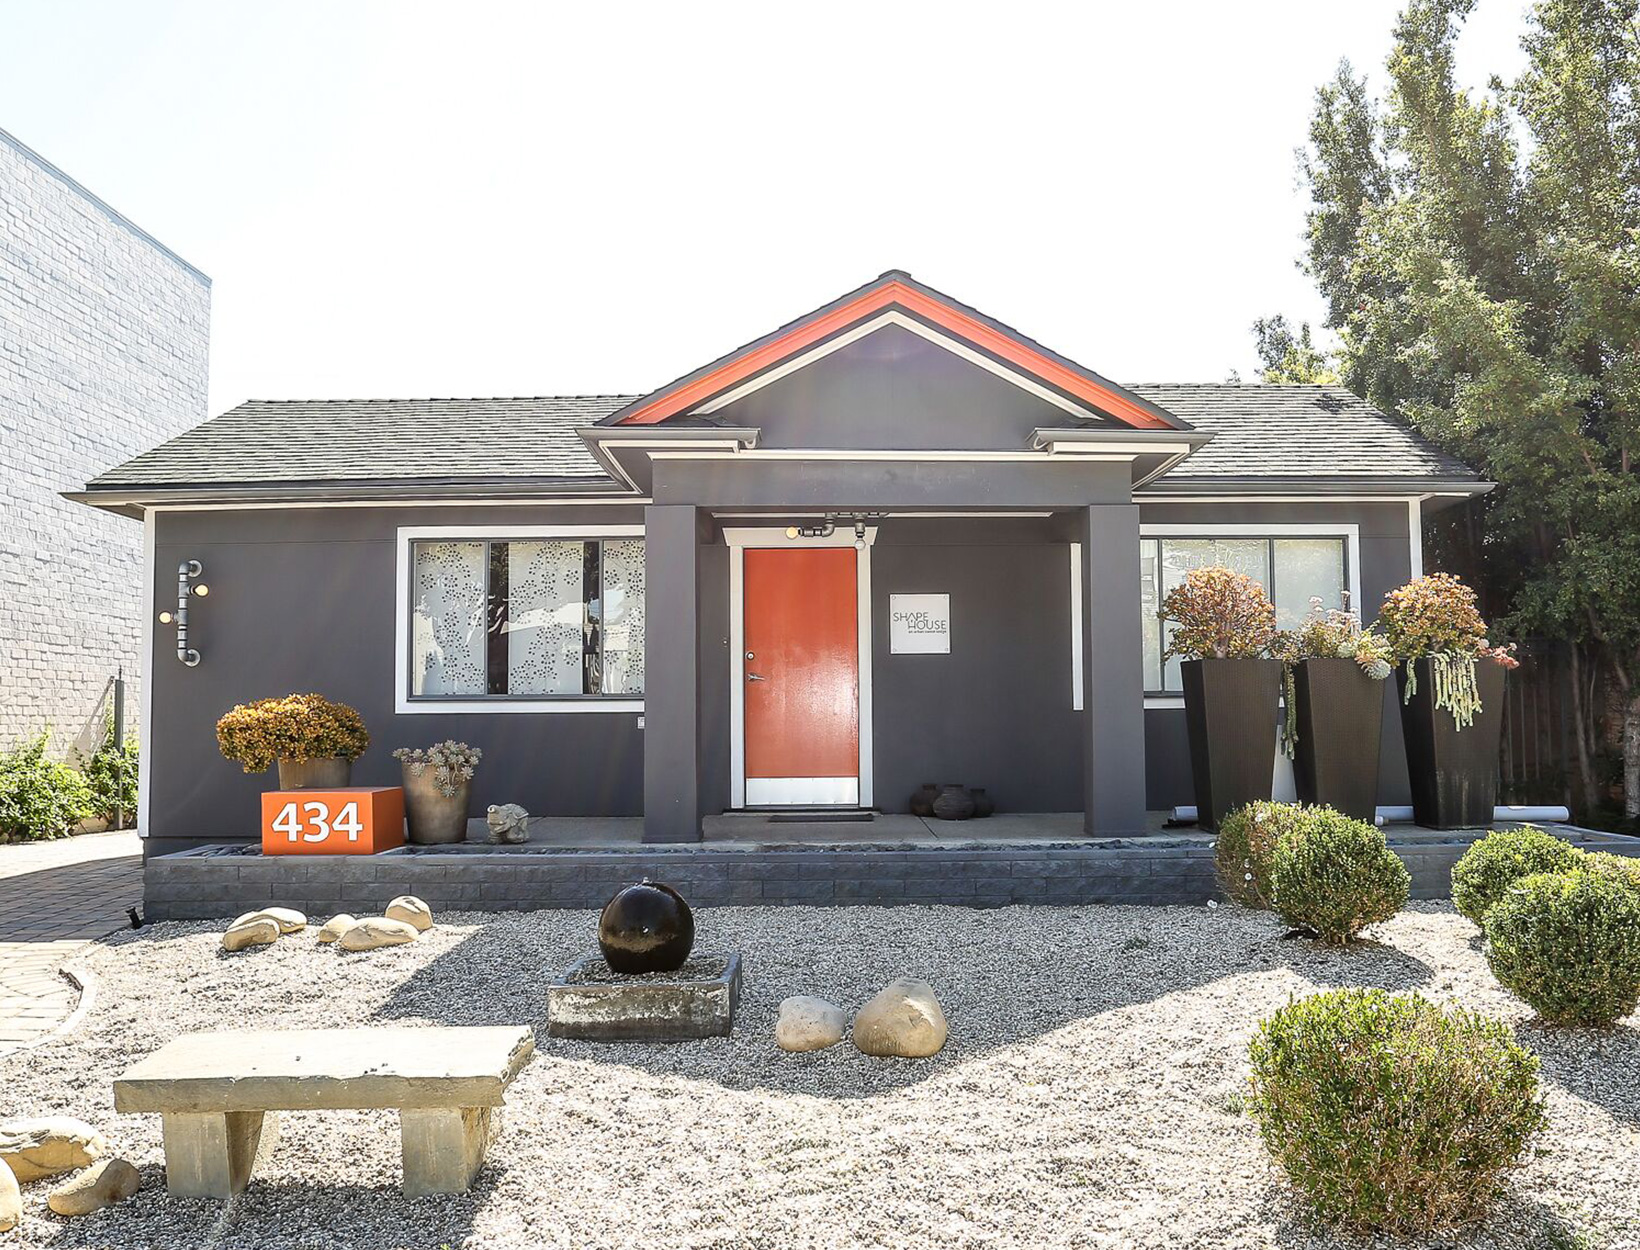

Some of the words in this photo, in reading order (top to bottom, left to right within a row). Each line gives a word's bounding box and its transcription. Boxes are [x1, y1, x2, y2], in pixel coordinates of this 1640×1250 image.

[893, 612, 929, 622] SHAPE
[907, 620, 947, 630] HOUSE
[271, 801, 364, 843] 434
